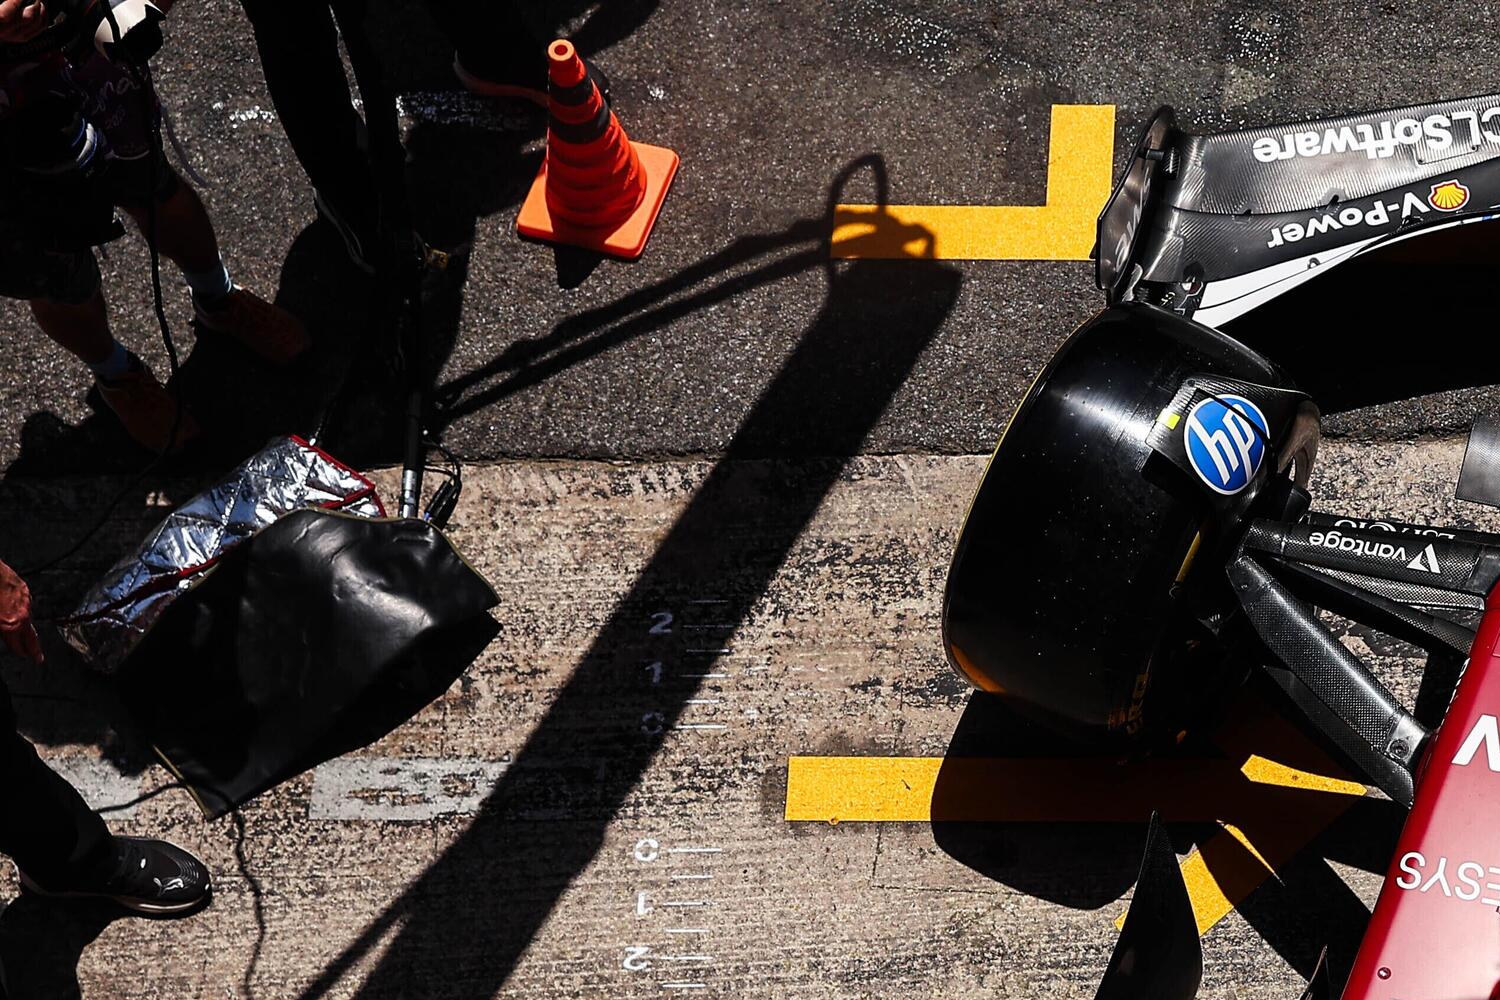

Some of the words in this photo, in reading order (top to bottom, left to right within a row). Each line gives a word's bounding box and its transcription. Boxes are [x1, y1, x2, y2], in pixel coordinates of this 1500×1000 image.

[1267, 192, 1431, 248] V-Power
[1187, 398, 1266, 492] hp
[1308, 529, 1407, 563] vantage
[649, 612, 673, 634] 2
[644, 662, 663, 684] 1
[634, 838, 659, 862] 0
[636, 892, 655, 916] 1
[622, 946, 650, 971] 2
